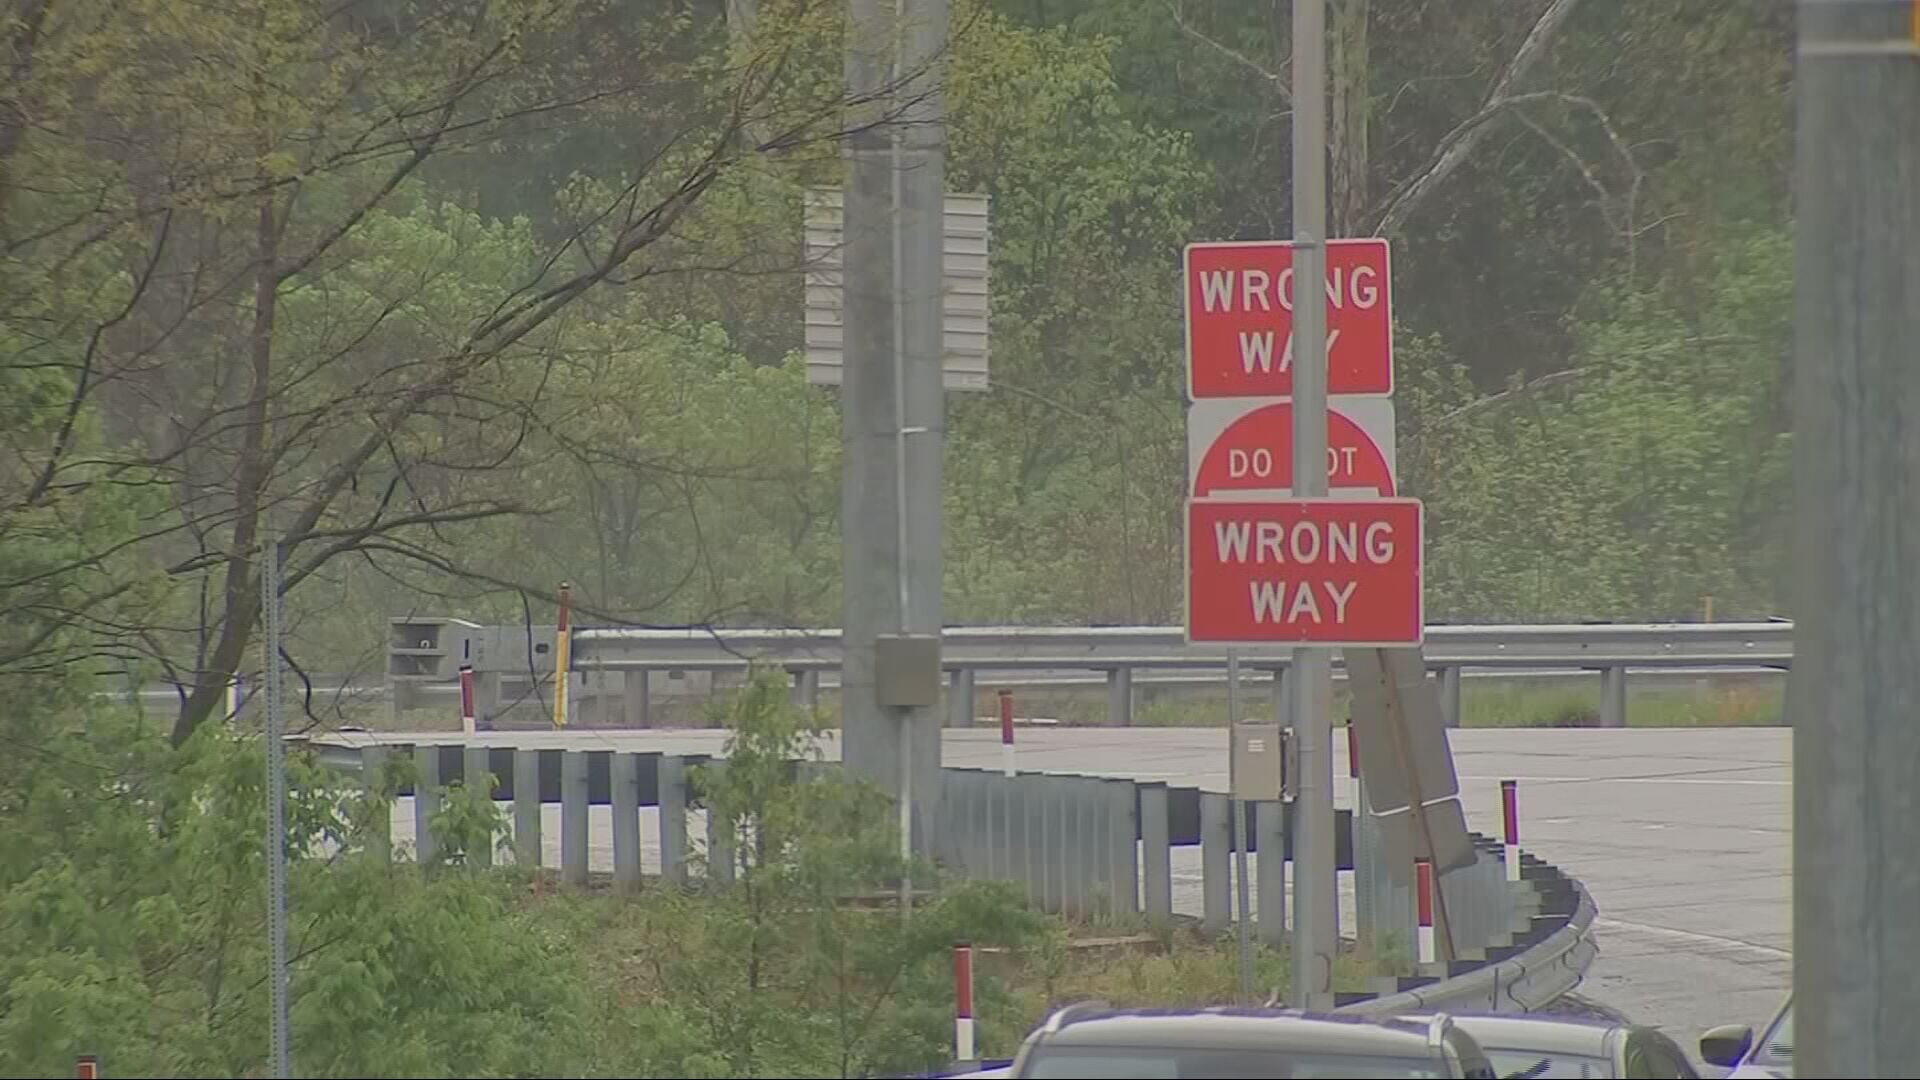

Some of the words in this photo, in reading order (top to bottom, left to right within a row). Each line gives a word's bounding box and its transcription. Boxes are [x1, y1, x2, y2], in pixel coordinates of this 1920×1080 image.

[1229, 447, 1273, 478] DO
[1326, 446, 1358, 476] OT
[1214, 520, 1395, 564] WRONG
[1249, 580, 1357, 624] WAY
